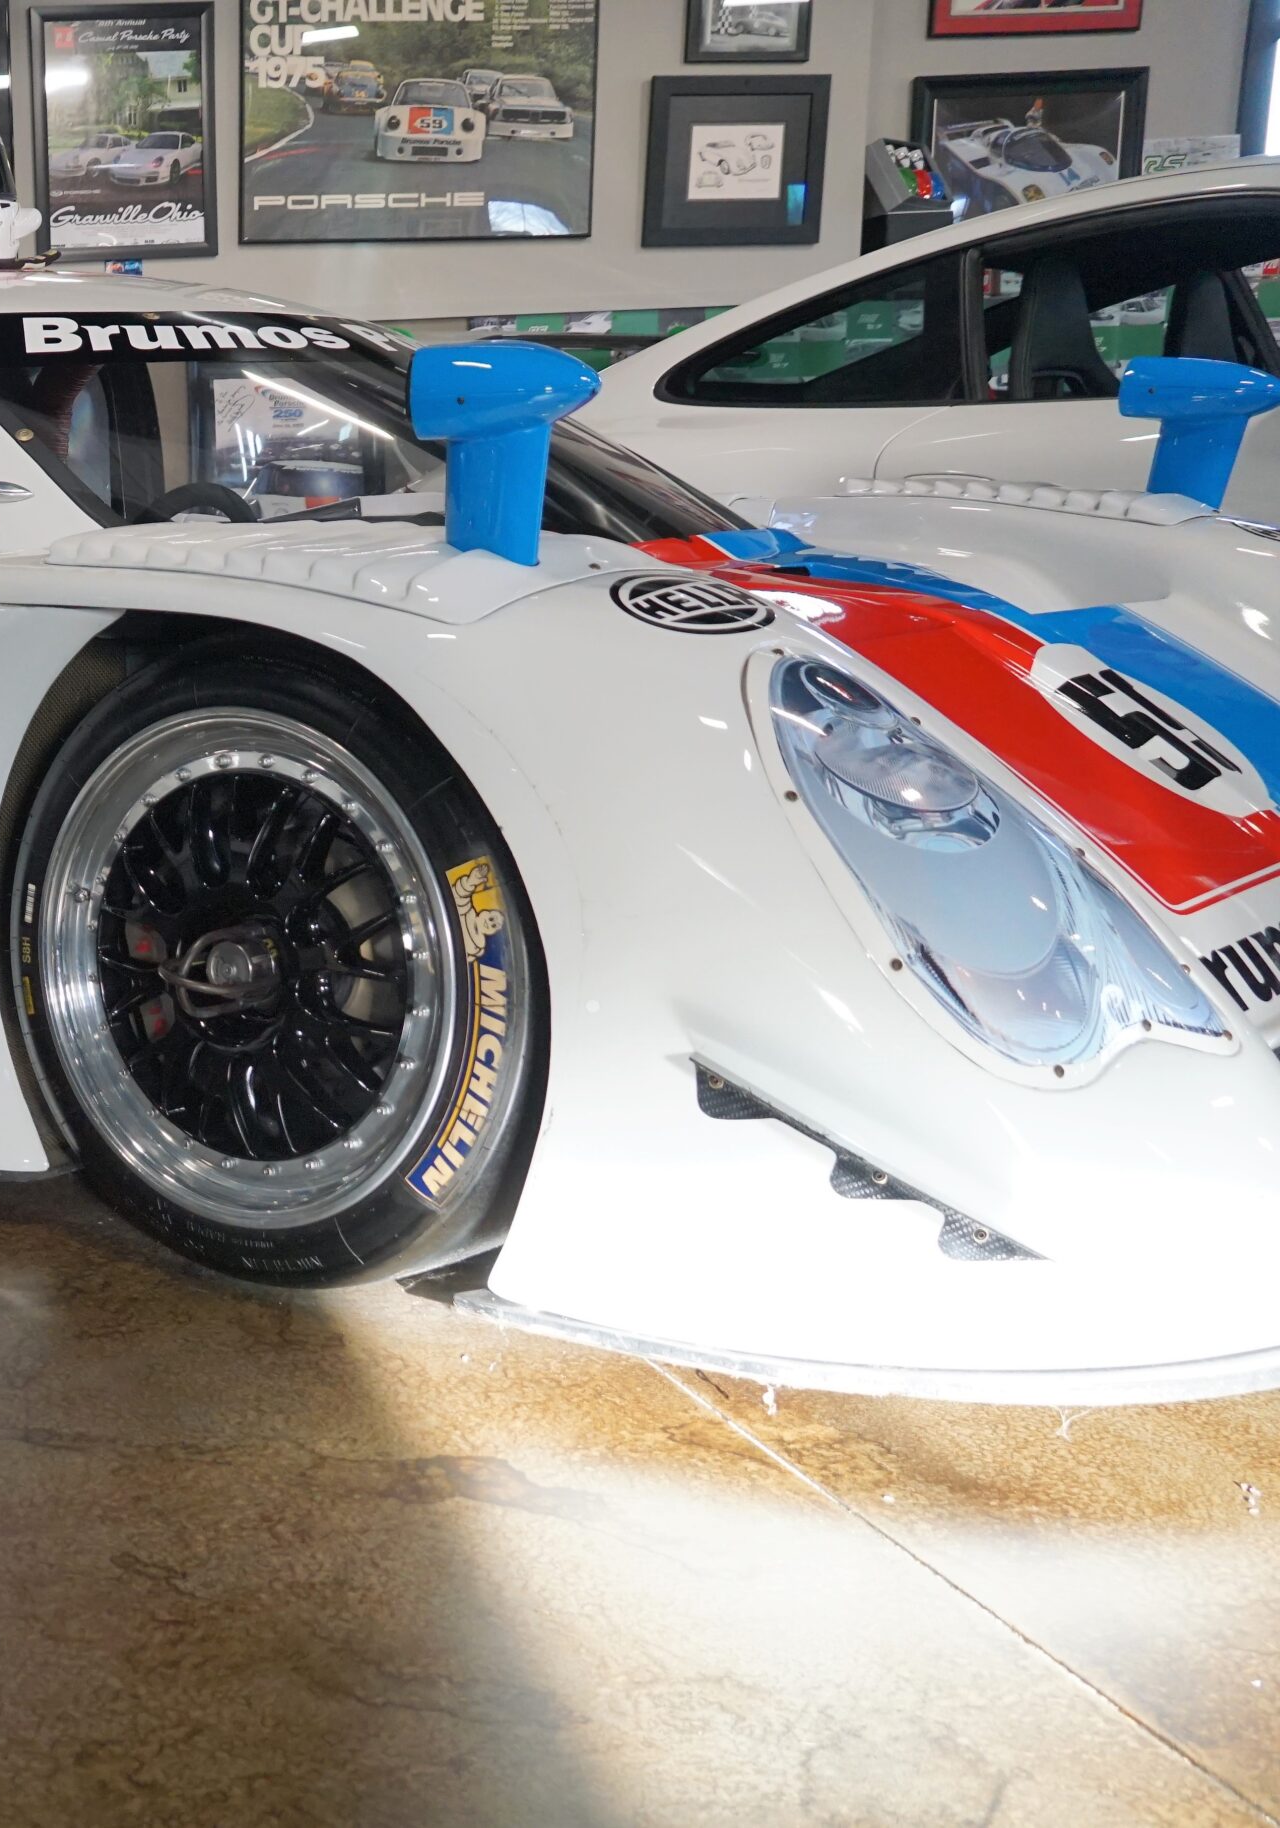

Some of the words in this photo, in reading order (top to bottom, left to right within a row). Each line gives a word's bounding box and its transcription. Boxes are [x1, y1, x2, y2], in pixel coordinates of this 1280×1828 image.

[250, 0, 484, 24] GT-CHALLENGE
[250, 24, 316, 56] CUP
[257, 56, 325, 89] 1975
[420, 118, 443, 129] 59
[50, 204, 148, 229] Granville
[147, 201, 205, 224] Ohio
[253, 191, 486, 212] PORSCHE
[21, 316, 352, 354] Brumos
[271, 407, 305, 419] 250
[421, 962, 509, 1197] MICHELIN
